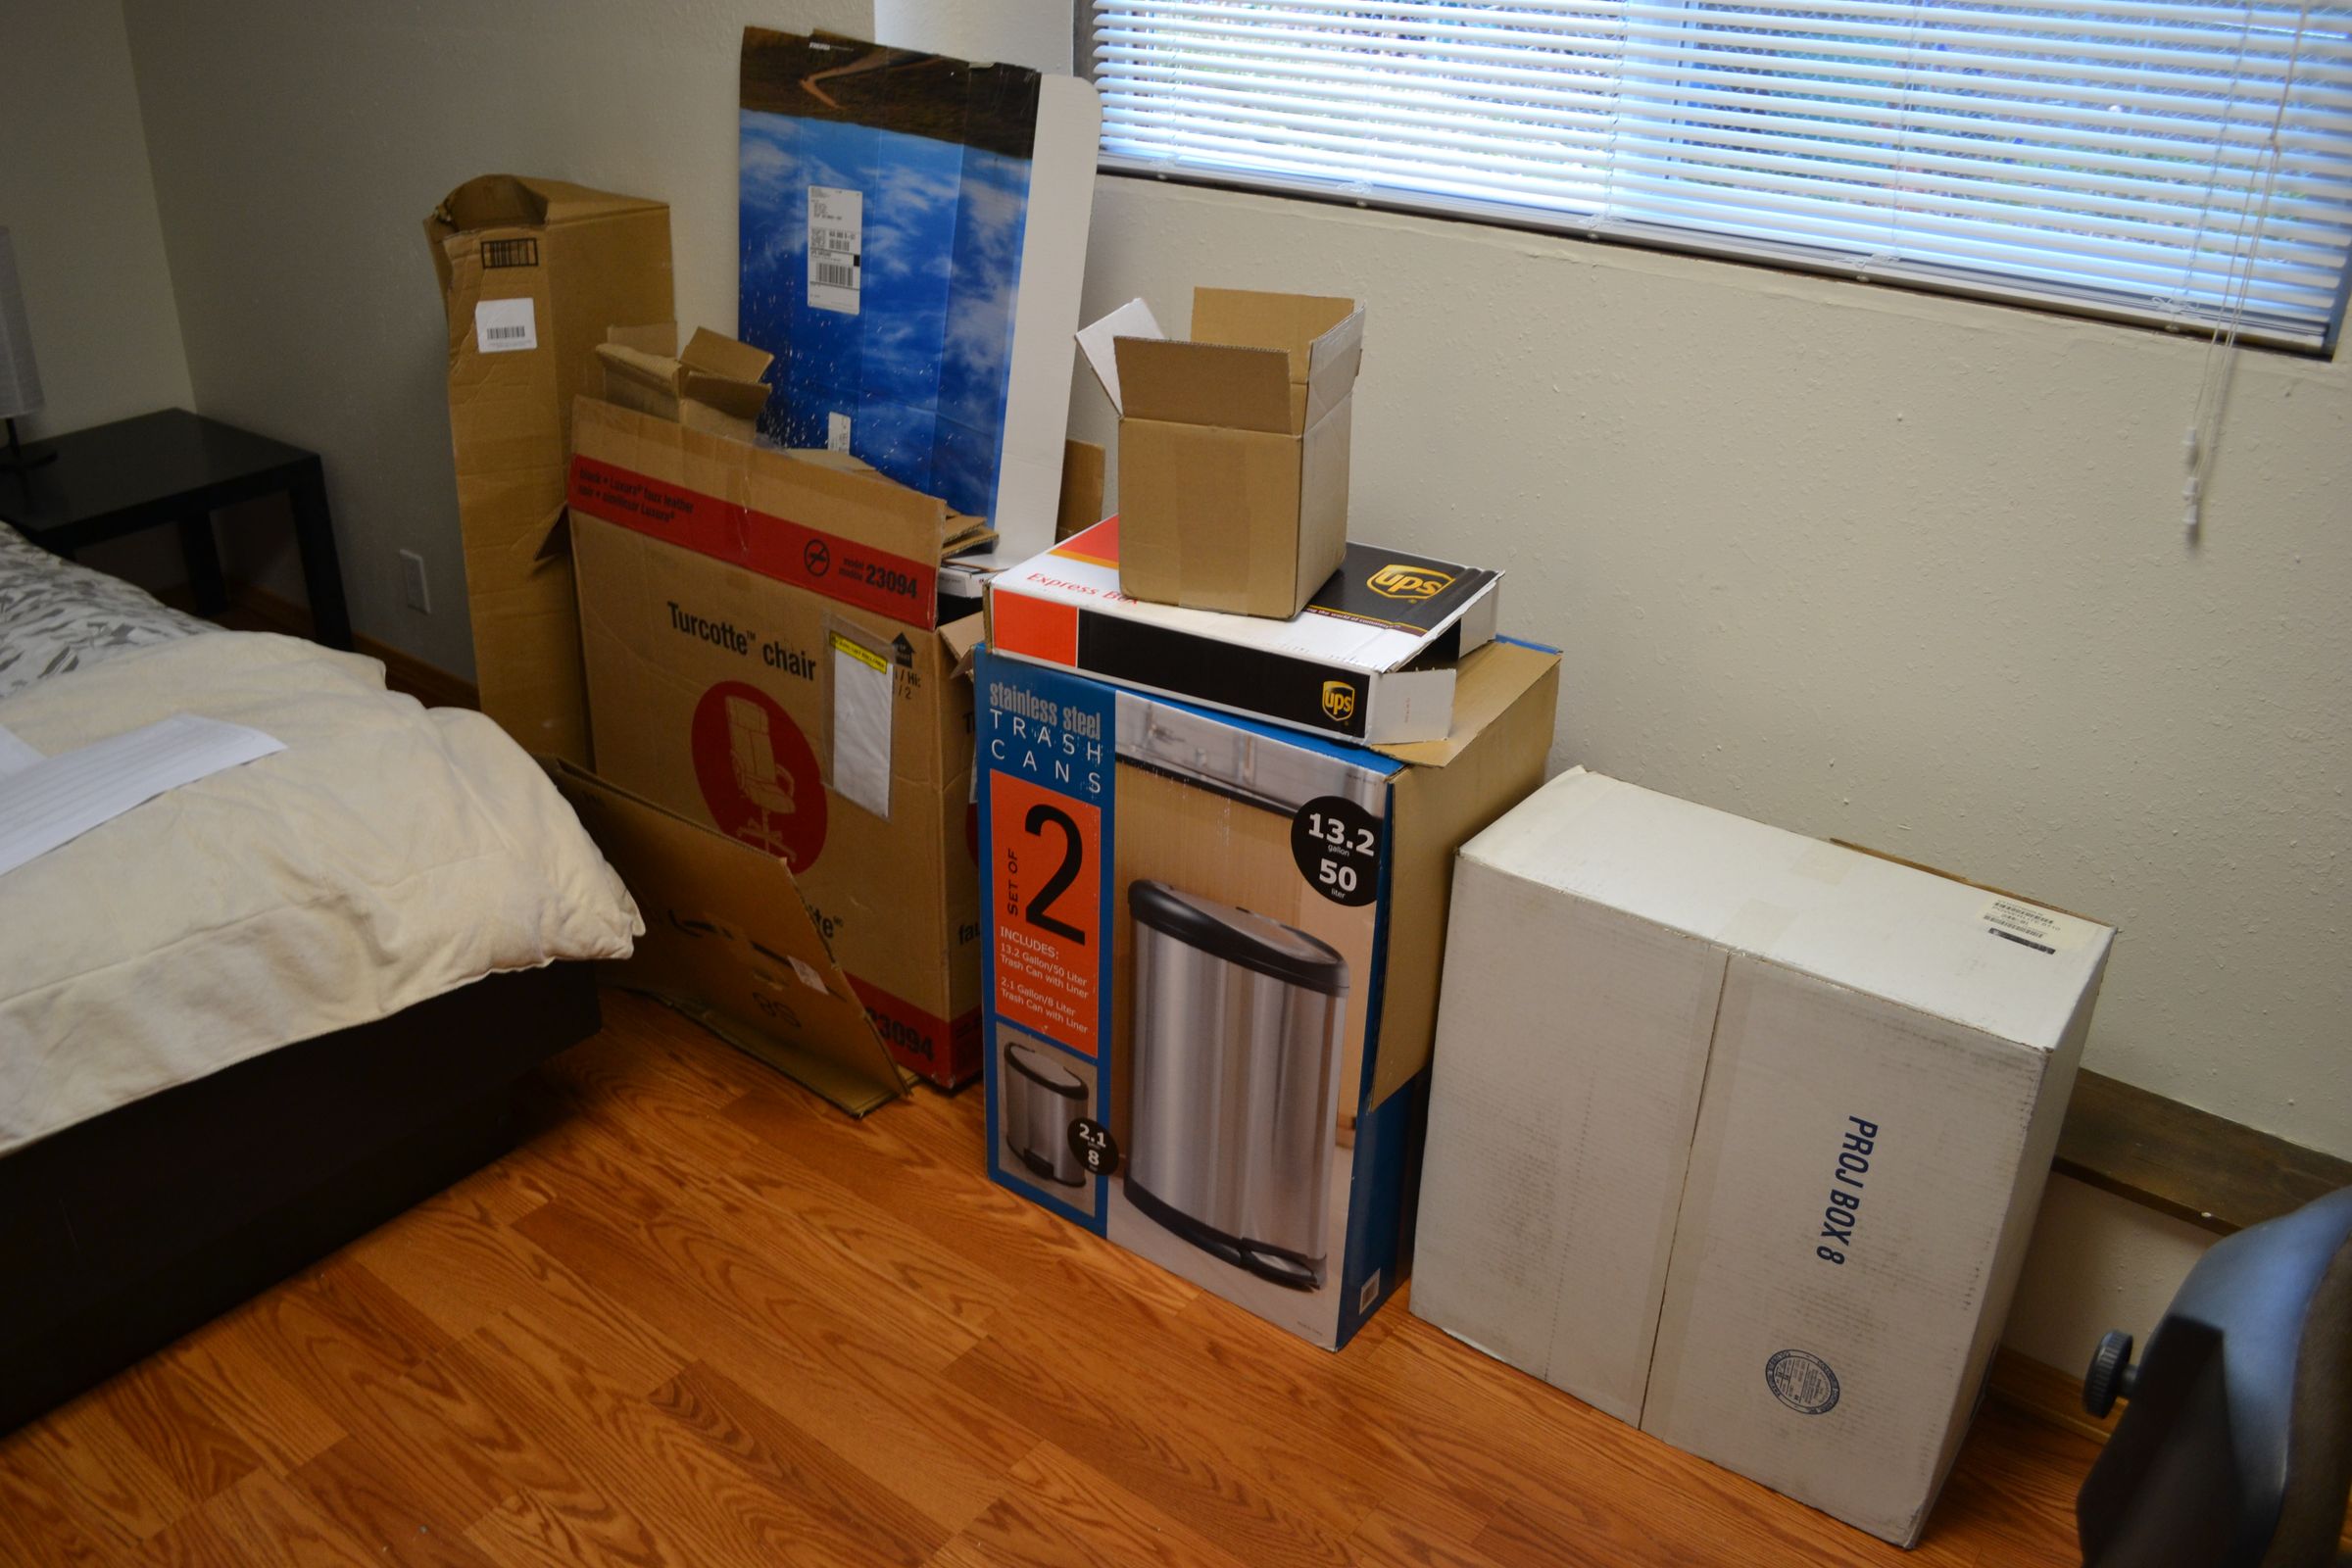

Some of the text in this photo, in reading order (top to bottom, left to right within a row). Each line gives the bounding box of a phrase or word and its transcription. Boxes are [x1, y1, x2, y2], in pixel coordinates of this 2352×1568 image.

[865, 564, 917, 599] 23094
[1026, 572, 1099, 595] Express
[1374, 570, 1443, 595] ups
[762, 641, 816, 681] chair
[990, 682, 1057, 726] stainless
[1062, 706, 1101, 741] steel
[1324, 689, 1351, 715] ups
[990, 709, 1101, 764] TRASH
[992, 739, 1101, 794] CANS
[1308, 812, 1374, 857] 13.2
[1328, 844, 1349, 858] gallon
[1007, 848, 1018, 917] SET OF
[1025, 804, 1085, 946] 2
[1319, 858, 1357, 892] 50
[1331, 888, 1346, 899] liter
[1000, 926, 1058, 959] INCLUDES:
[1001, 943, 1088, 986] 13.2 Gallon/50 Liter
[1001, 954, 1089, 998] Trash Can with Liner
[1001, 977, 1076, 1016] 2.1 Gallon/8 Liter
[1001, 988, 1088, 1034] Trash Can with Liner
[1079, 1123, 1106, 1148] 2.1
[1088, 1150, 1099, 1165] 8
[1816, 1115, 1879, 1265] PROJ BOX 8
